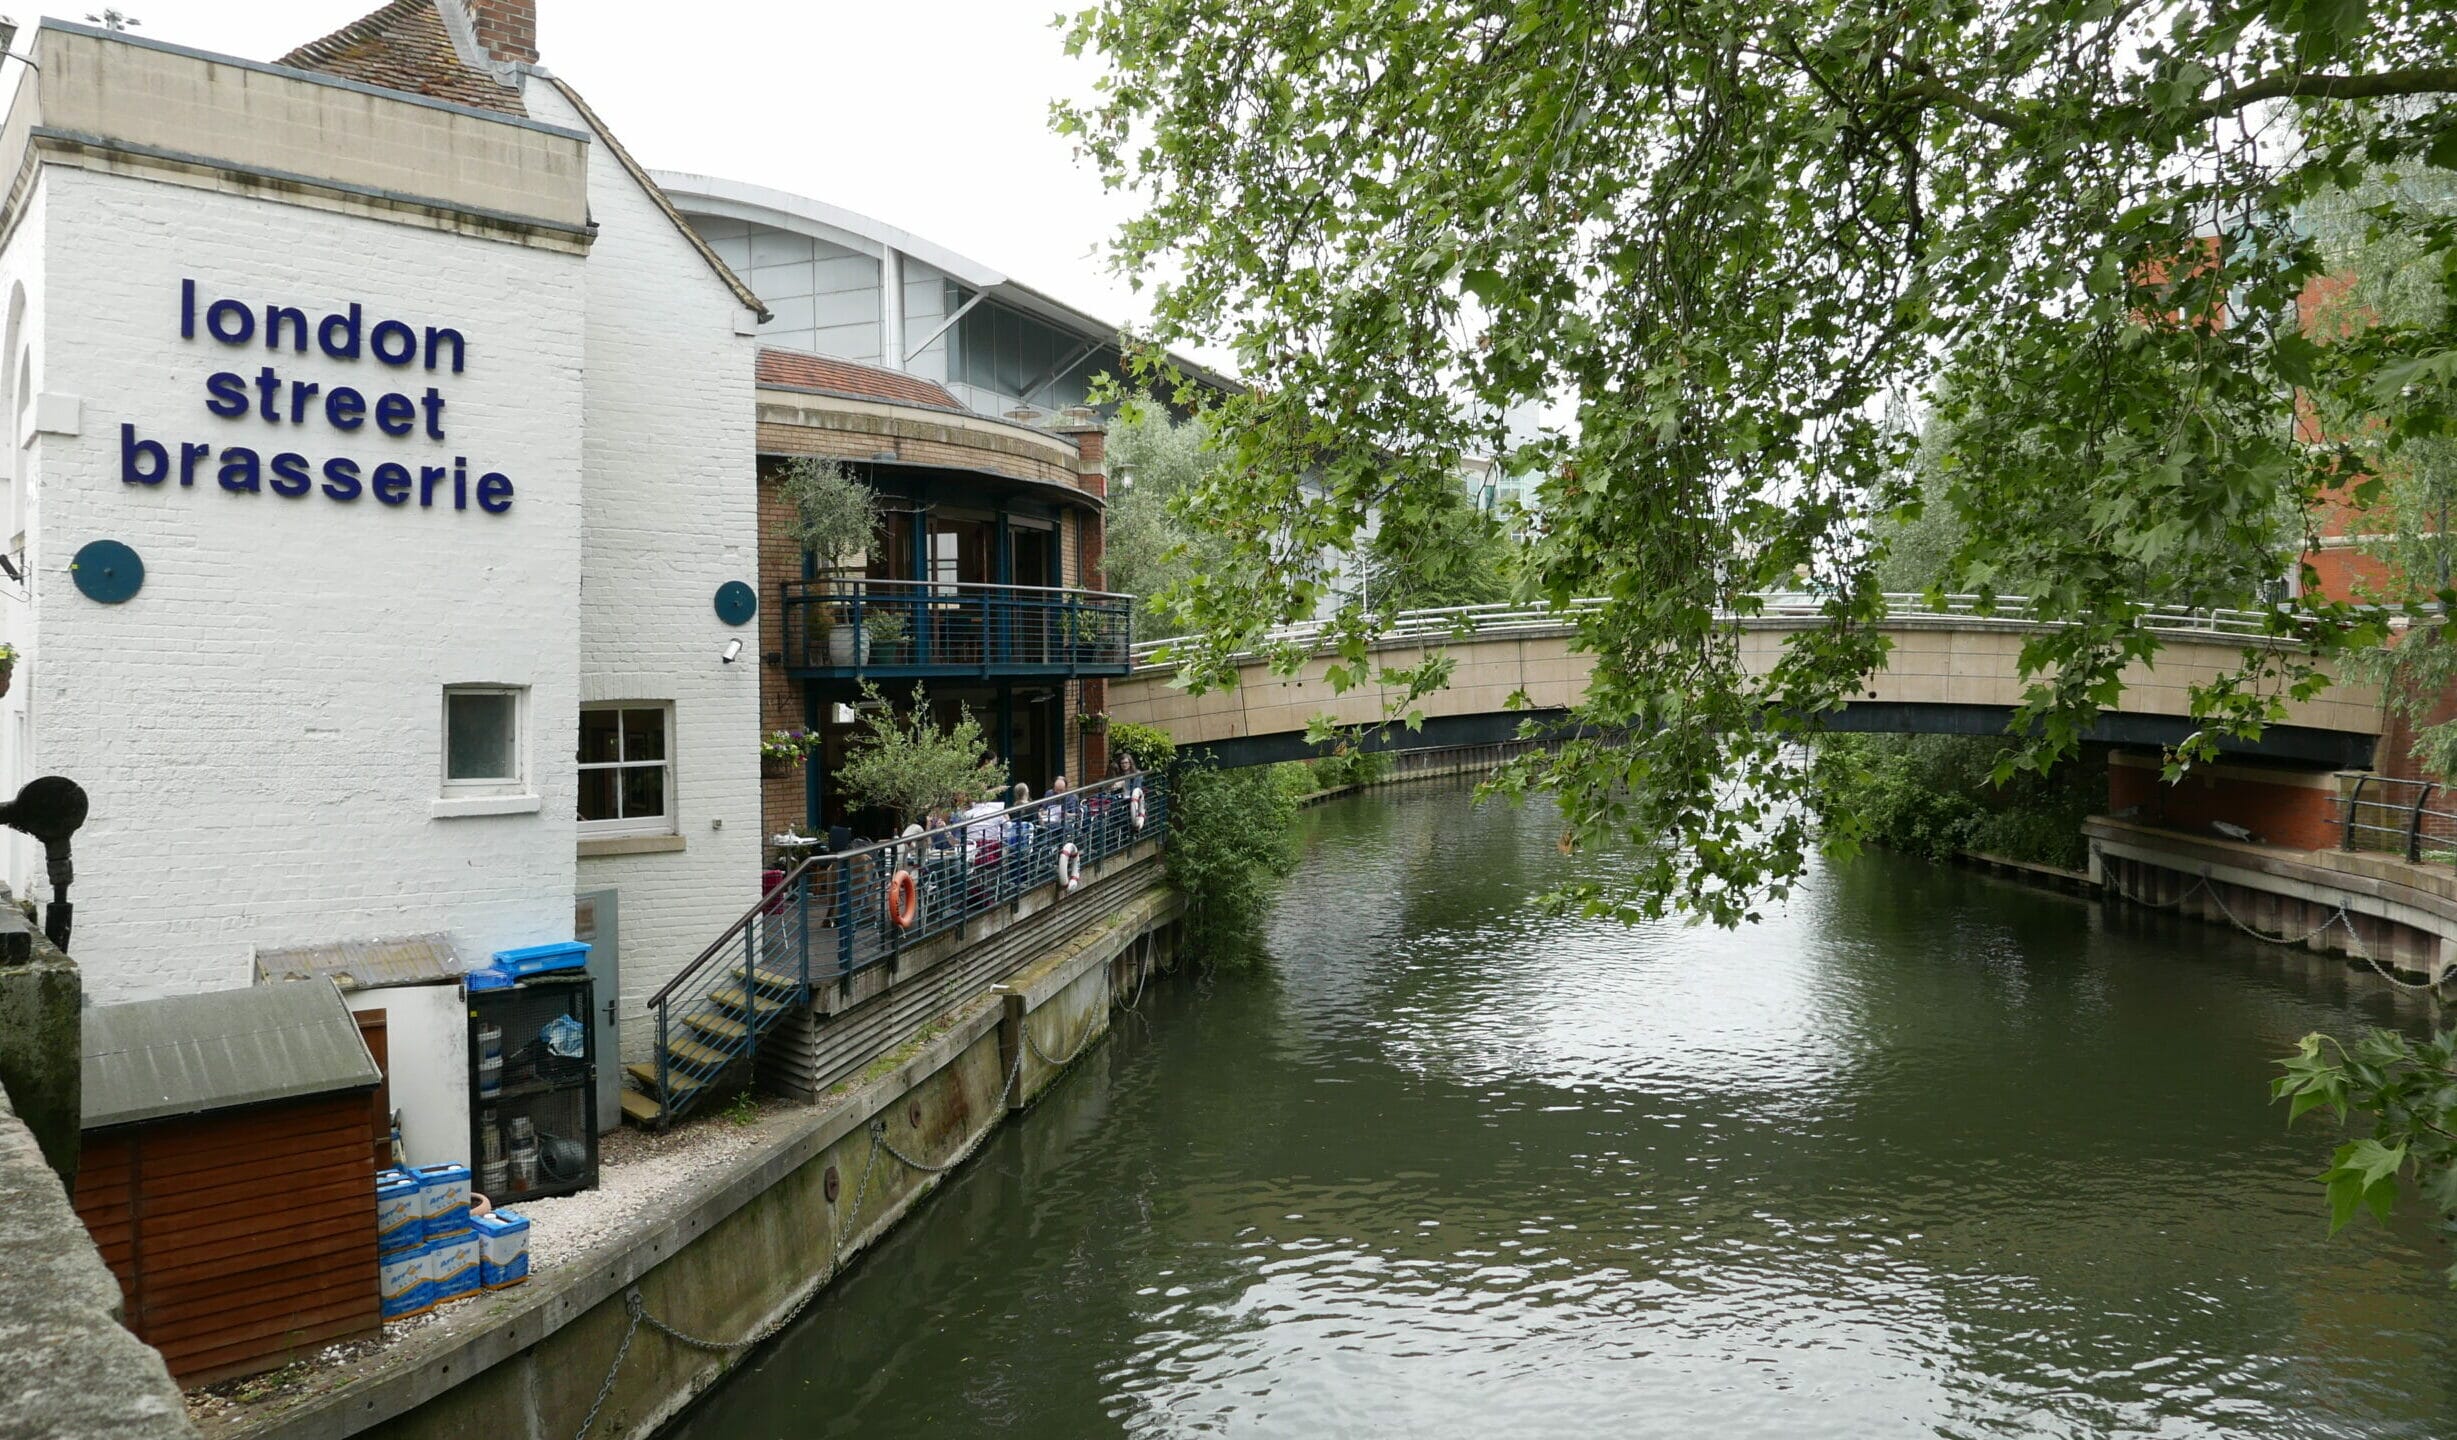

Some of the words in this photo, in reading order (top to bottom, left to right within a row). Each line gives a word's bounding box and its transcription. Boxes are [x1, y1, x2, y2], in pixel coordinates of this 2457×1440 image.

[181, 279, 465, 373] london
[206, 366, 445, 440] street
[121, 423, 514, 514] brasserie
